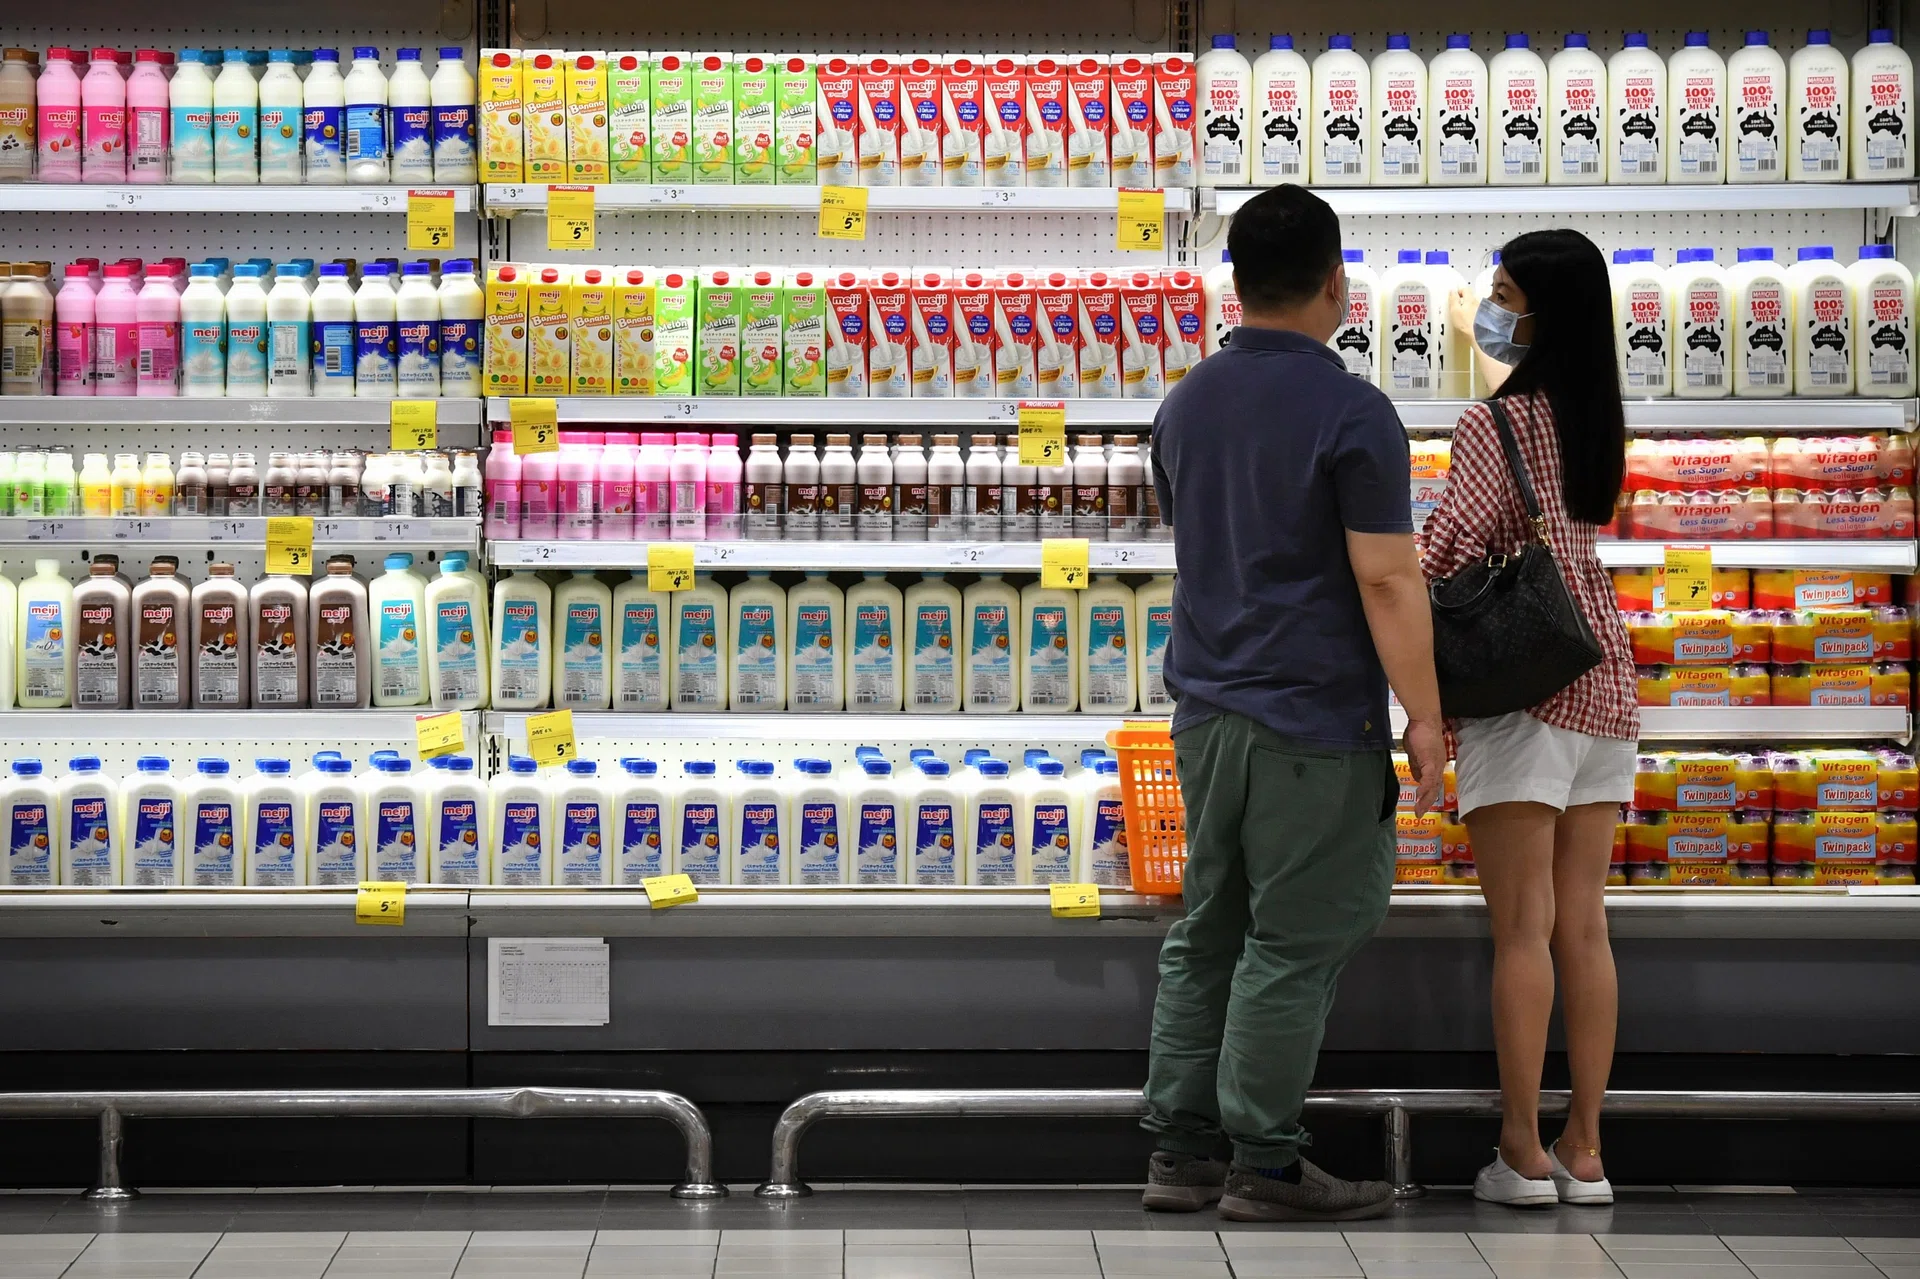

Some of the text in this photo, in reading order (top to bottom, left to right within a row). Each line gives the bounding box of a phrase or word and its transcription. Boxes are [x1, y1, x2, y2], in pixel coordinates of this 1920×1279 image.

[491, 76, 513, 84] meiji
[615, 79, 640, 88] meiji
[823, 80, 852, 92] meiji
[1074, 80, 1103, 92] meiji
[1161, 79, 1190, 91] meiji
[990, 81, 1019, 93] meiji
[1625, 87, 1655, 97] 100%
[1742, 85, 1772, 95] 100%
[1267, 89, 1297, 99] 100%
[1387, 89, 1417, 99] 100%
[484, 98, 520, 112] Banana
[568, 101, 604, 115] Banana
[48, 111, 77, 123] meiji
[404, 111, 429, 123] meiji
[439, 109, 468, 121] meiji
[538, 291, 560, 299] meiji
[706, 293, 731, 302] meiji
[832, 294, 861, 306] meiji
[876, 294, 905, 306] meiji
[1043, 294, 1072, 306] meiji
[1169, 293, 1198, 305] meiji
[1397, 304, 1427, 314] 100%
[1814, 299, 1844, 309] 100%
[488, 312, 524, 326] Banana
[531, 313, 567, 327] Banana
[617, 315, 653, 329] Banana
[193, 327, 220, 338] meiji
[359, 325, 388, 338] meiji
[400, 325, 430, 337] meiji
[1672, 454, 1730, 467] Vitagen
[1817, 452, 1877, 465] Vitagen
[1677, 466, 1726, 475] Less Sugar
[1823, 464, 1875, 474] Less Sugar
[865, 487, 886, 495] meiji
[1077, 488, 1098, 496] meiji
[1674, 504, 1731, 517] Vitagen
[1820, 502, 1879, 515] Vitagen
[1679, 516, 1728, 526] Less Sugar
[1805, 573, 1840, 582] Less Sugar
[31, 605, 59, 620] meiji
[83, 607, 111, 619] meiji
[204, 607, 232, 619] meiji
[321, 607, 349, 619] meiji
[384, 604, 411, 616] meiji
[507, 605, 534, 617] meiji
[627, 608, 654, 620] meiji
[920, 610, 947, 622] meiji
[1036, 611, 1063, 623] meiji
[1678, 617, 1725, 628] Vitagen
[1819, 615, 1866, 626] Vitagen
[1841, 627, 1860, 635] Sugar
[1675, 670, 1722, 681] Vitagen
[1816, 668, 1863, 678] Vitagen
[1681, 763, 1728, 773] Vitagen
[1703, 774, 1722, 783] Sugar
[15, 809, 43, 821] meiji
[322, 807, 350, 819] meiji
[444, 805, 472, 817] meiji
[568, 807, 596, 819] meiji
[805, 808, 833, 820] meiji
[921, 809, 949, 821] meiji
[1396, 816, 1436, 827] itagen
[1673, 815, 1721, 826] Vitagen
[1413, 843, 1436, 857] pack
